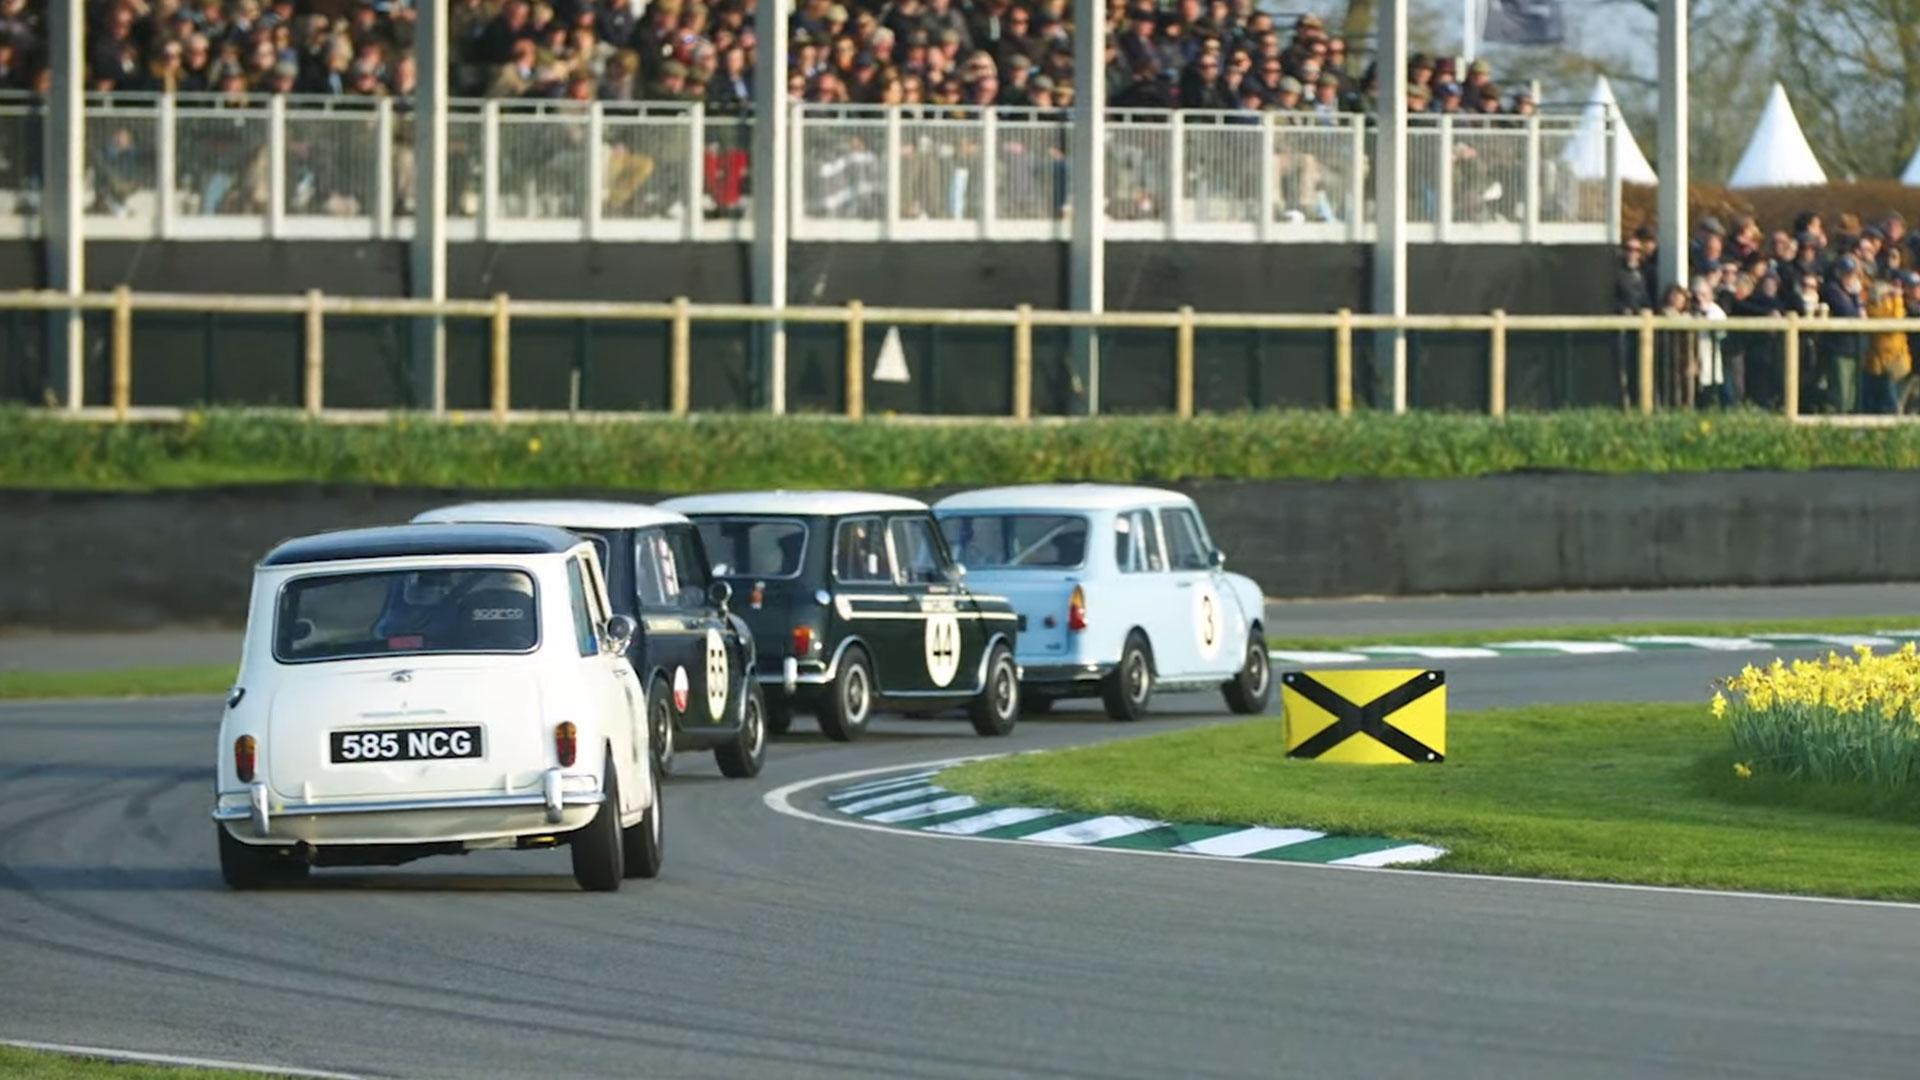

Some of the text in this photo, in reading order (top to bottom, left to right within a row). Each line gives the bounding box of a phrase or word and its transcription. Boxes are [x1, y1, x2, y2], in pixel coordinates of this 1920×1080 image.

[1202, 595, 1215, 646] 3
[932, 623, 953, 667] 44
[341, 730, 472, 759] 585 NCG
